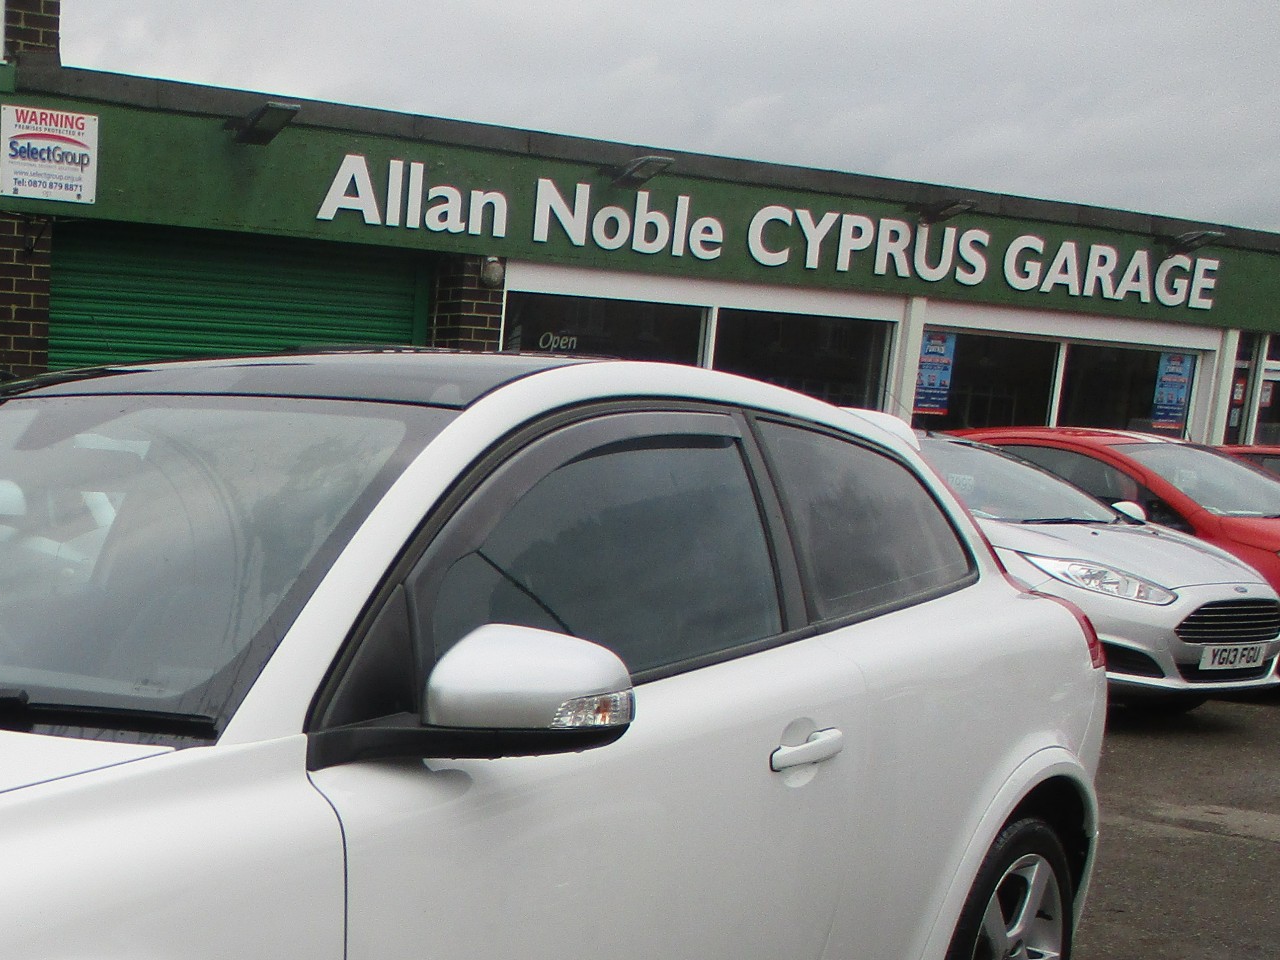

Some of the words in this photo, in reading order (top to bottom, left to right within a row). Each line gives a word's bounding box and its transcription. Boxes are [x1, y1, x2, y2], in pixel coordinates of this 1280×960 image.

[14, 108, 85, 131] WARNING
[14, 124, 42, 132] PREMISES
[44, 127, 75, 136] PROTECTED
[8, 140, 90, 173] SelectGroup
[13, 178, 27, 188] Tel:
[28, 181, 47, 189] 0870
[48, 182, 63, 191] 879
[64, 183, 83, 192] 8871
[316, 154, 508, 239] Allan
[533, 178, 724, 261] Noble
[747, 205, 990, 286] CYPRUS
[1003, 235, 1220, 311] GARAGE
[538, 331, 578, 351] Open
[1211, 647, 1238, 666] YG13
